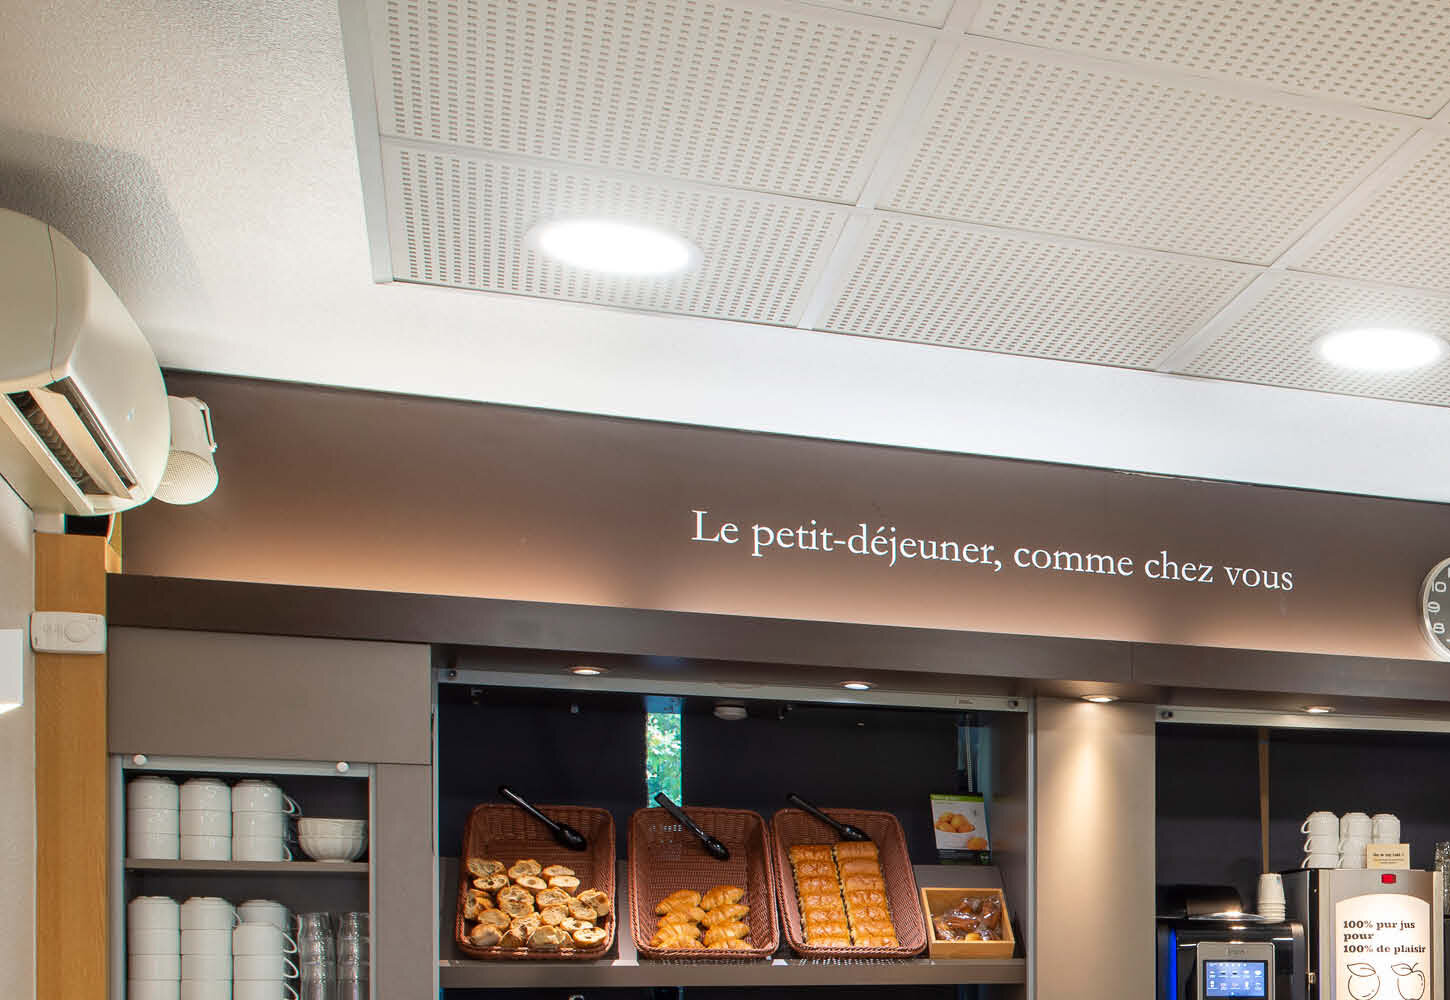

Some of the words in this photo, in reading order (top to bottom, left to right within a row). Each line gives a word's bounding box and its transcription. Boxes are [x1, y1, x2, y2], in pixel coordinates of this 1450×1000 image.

[690, 509, 740, 544] Le
[751, 519, 1002, 573] petit-déjeuner,
[1013, 547, 1134, 577] comme
[1144, 550, 1214, 583] chez
[1223, 566, 1294, 591] vous
[1427, 601, 1441, 613] 9
[1433, 622, 1446, 634] 8
[1343, 919, 1374, 929] 100%
[1376, 921, 1398, 931] pur
[1400, 920, 1416, 931] jus
[1343, 932, 1375, 943] pour
[1343, 944, 1374, 953] 100%
[1376, 944, 1391, 953] de
[1393, 944, 1426, 956] plaisir
